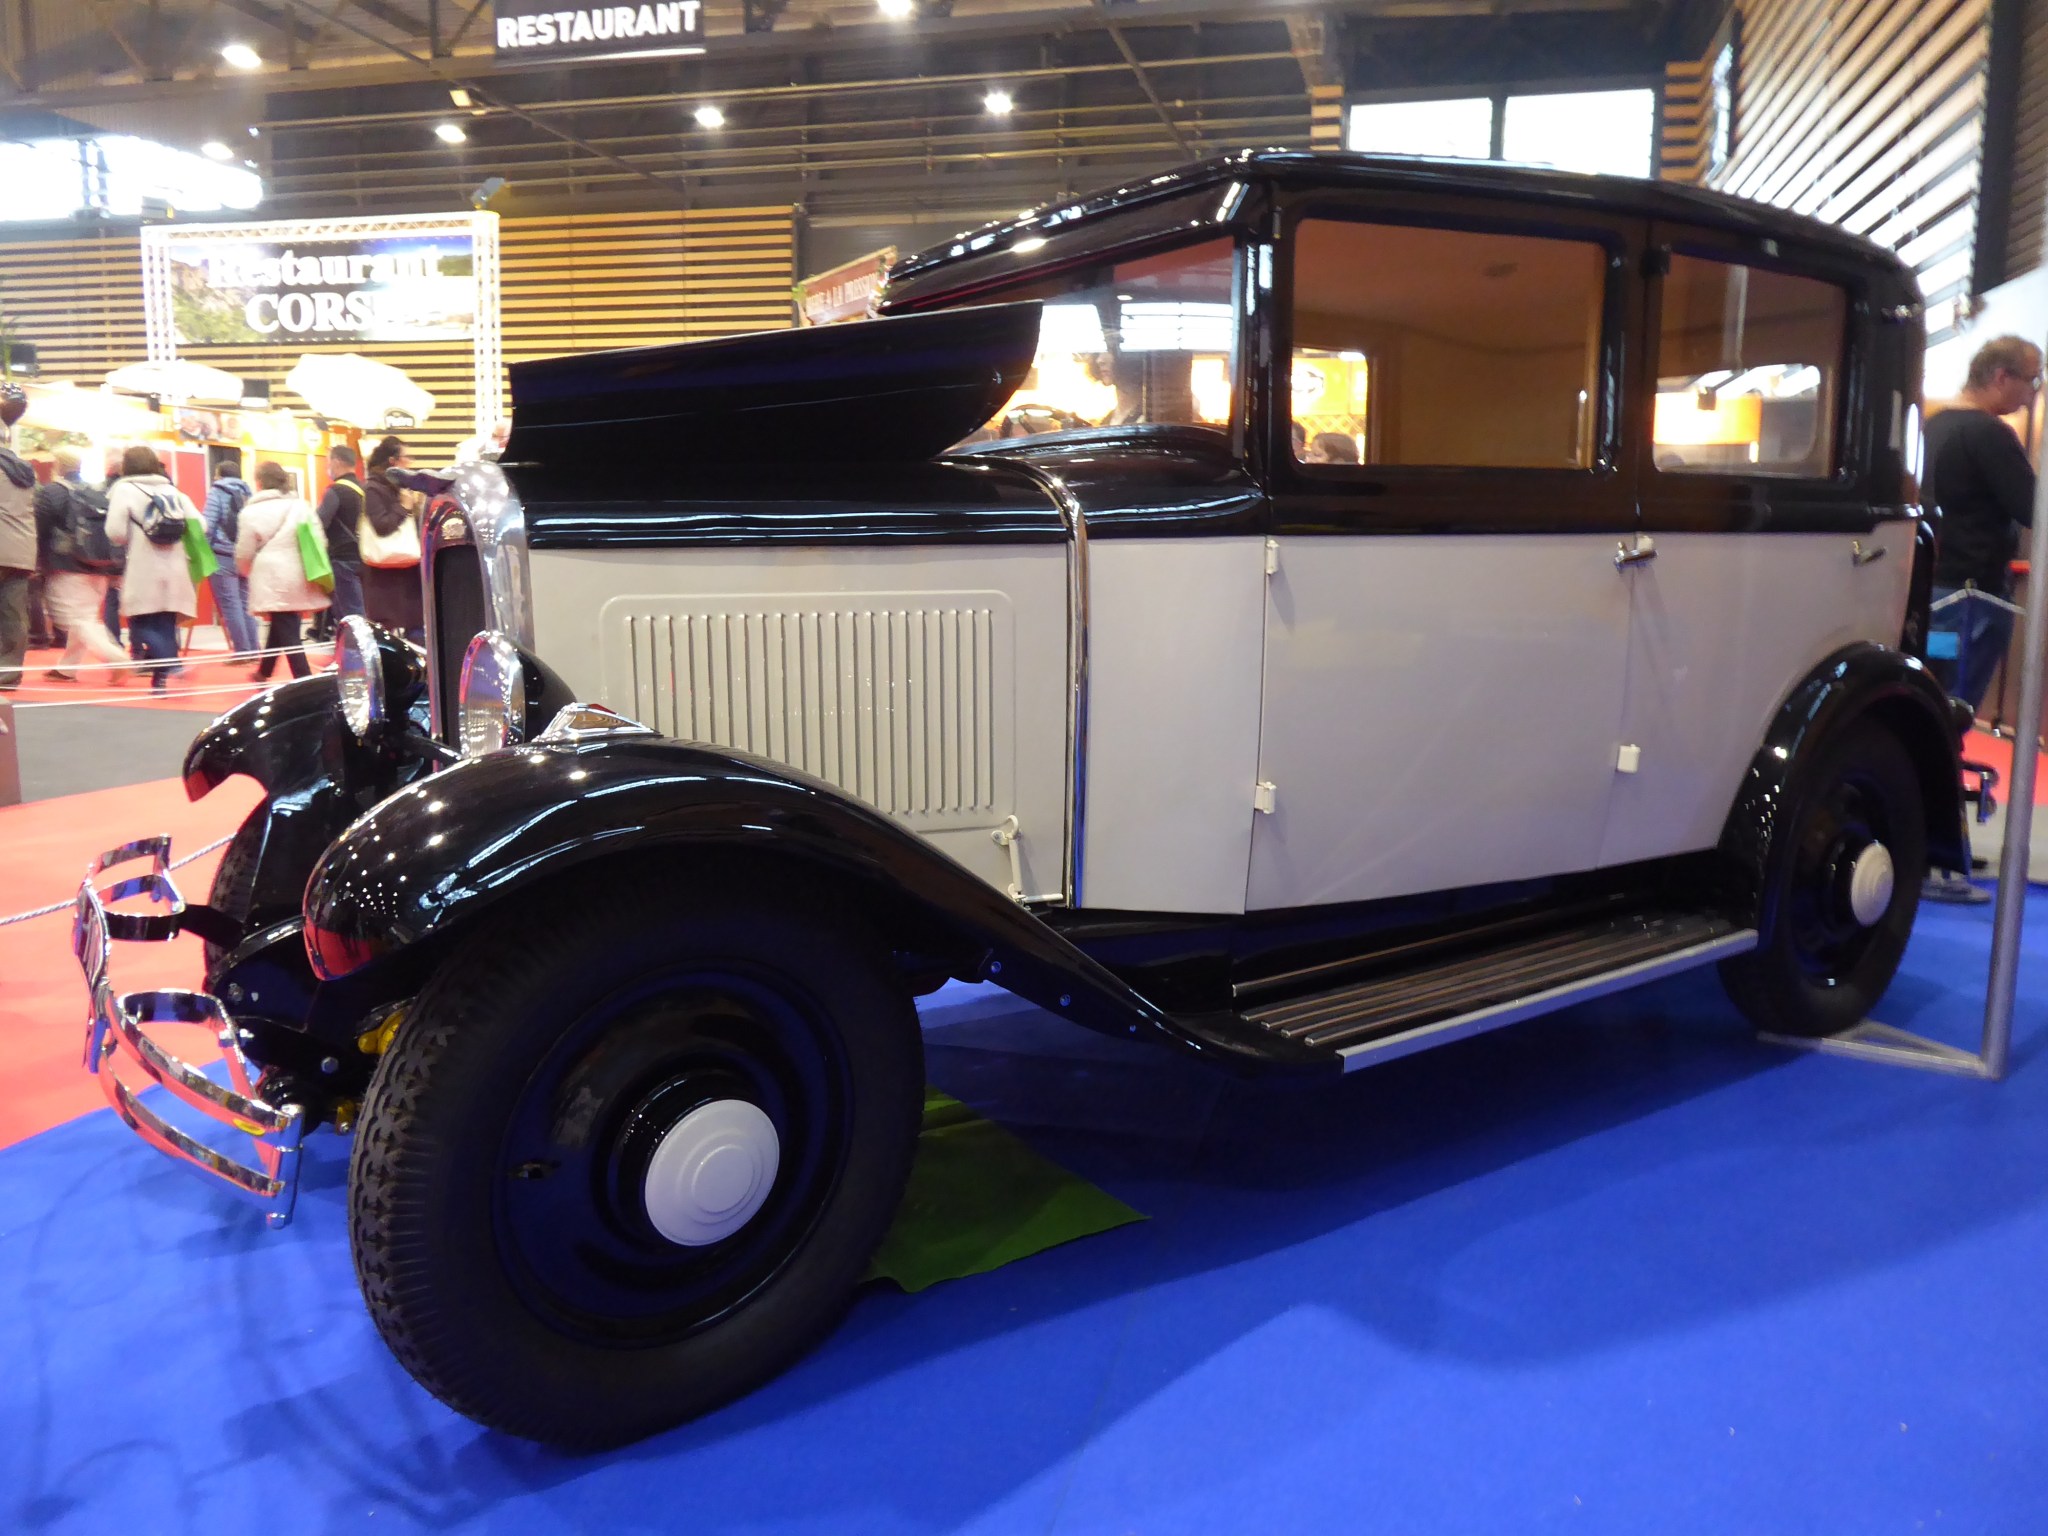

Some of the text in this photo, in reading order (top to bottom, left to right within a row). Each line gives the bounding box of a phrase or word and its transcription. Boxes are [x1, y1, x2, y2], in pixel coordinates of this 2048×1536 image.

[496, 1, 701, 48] RESTAURANT
[207, 245, 442, 288] Restaurant
[245, 291, 399, 333] CORS
